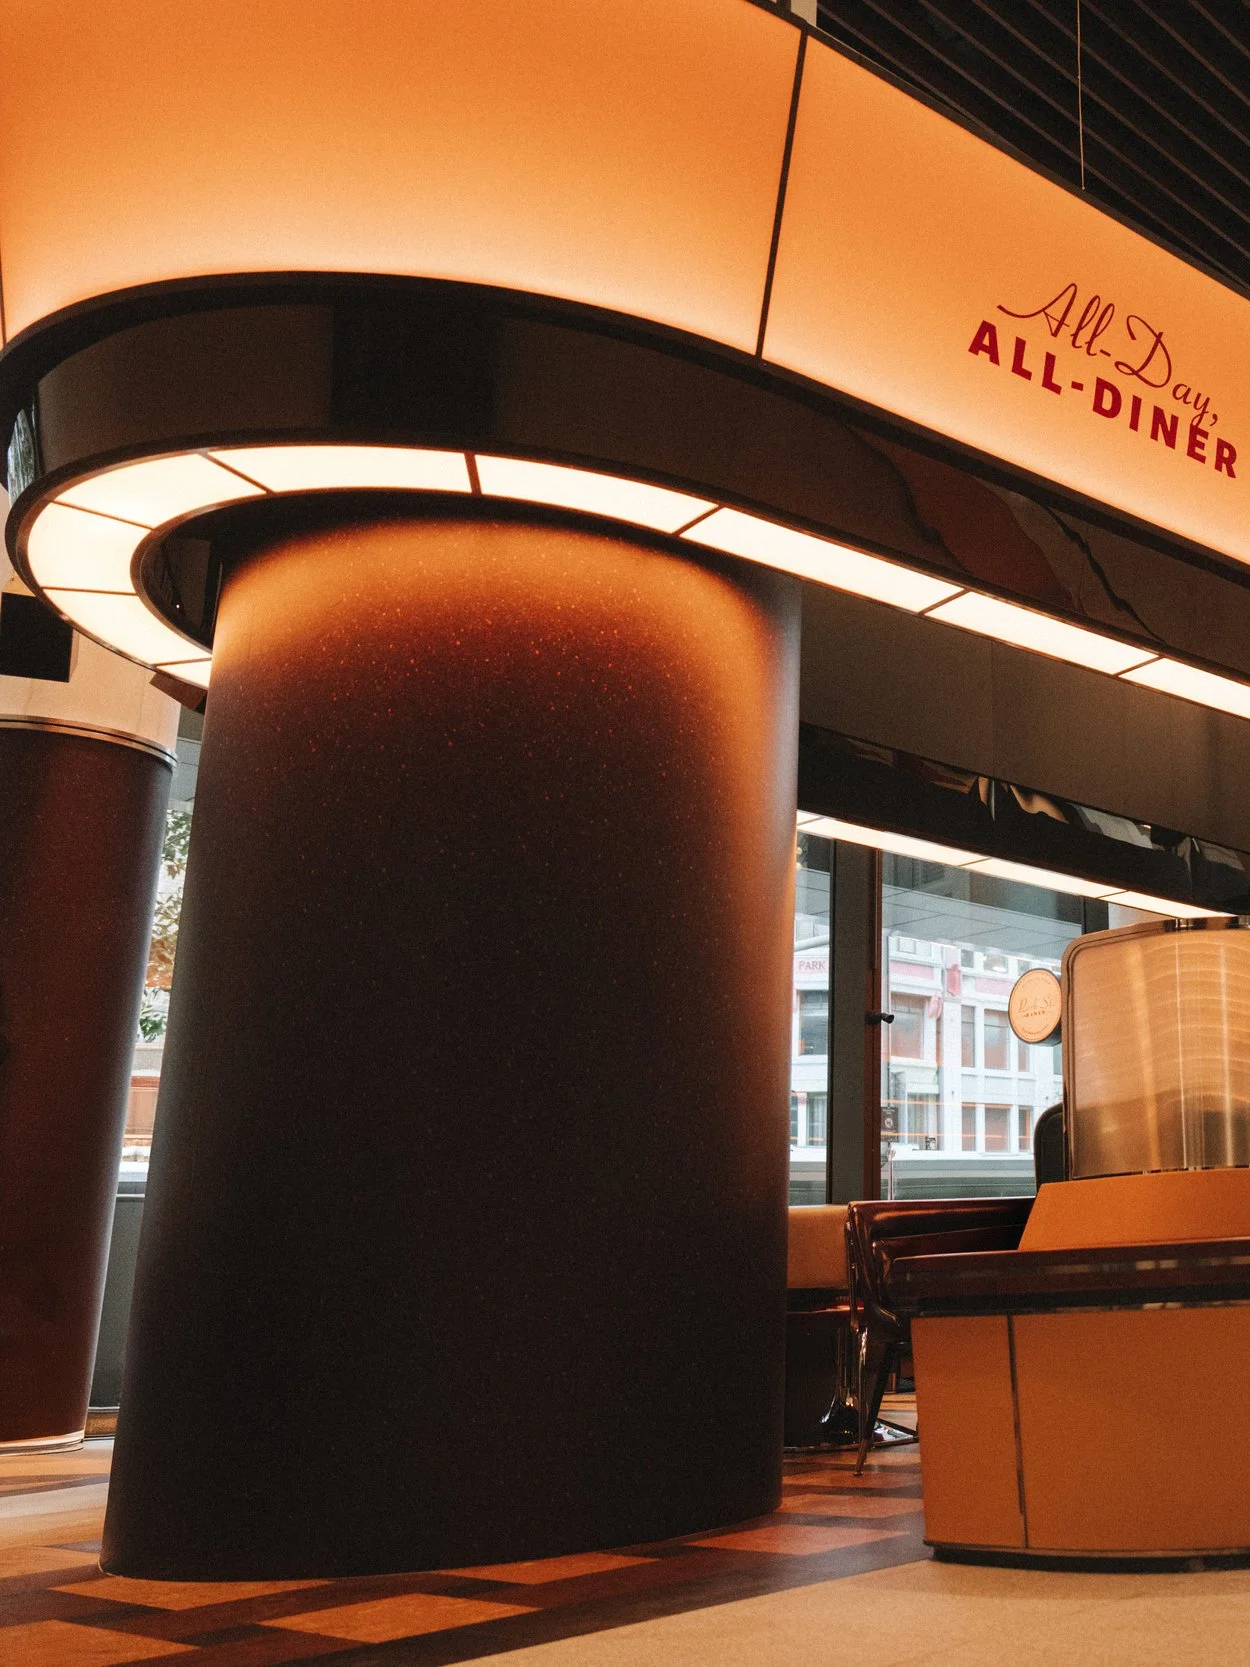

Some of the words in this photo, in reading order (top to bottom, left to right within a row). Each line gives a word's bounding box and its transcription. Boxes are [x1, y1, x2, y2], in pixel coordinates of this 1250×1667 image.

[968, 320, 1238, 479] ALL-DINER
[997, 283, 1218, 427] All-Day,
[798, 960, 826, 970] PARK
